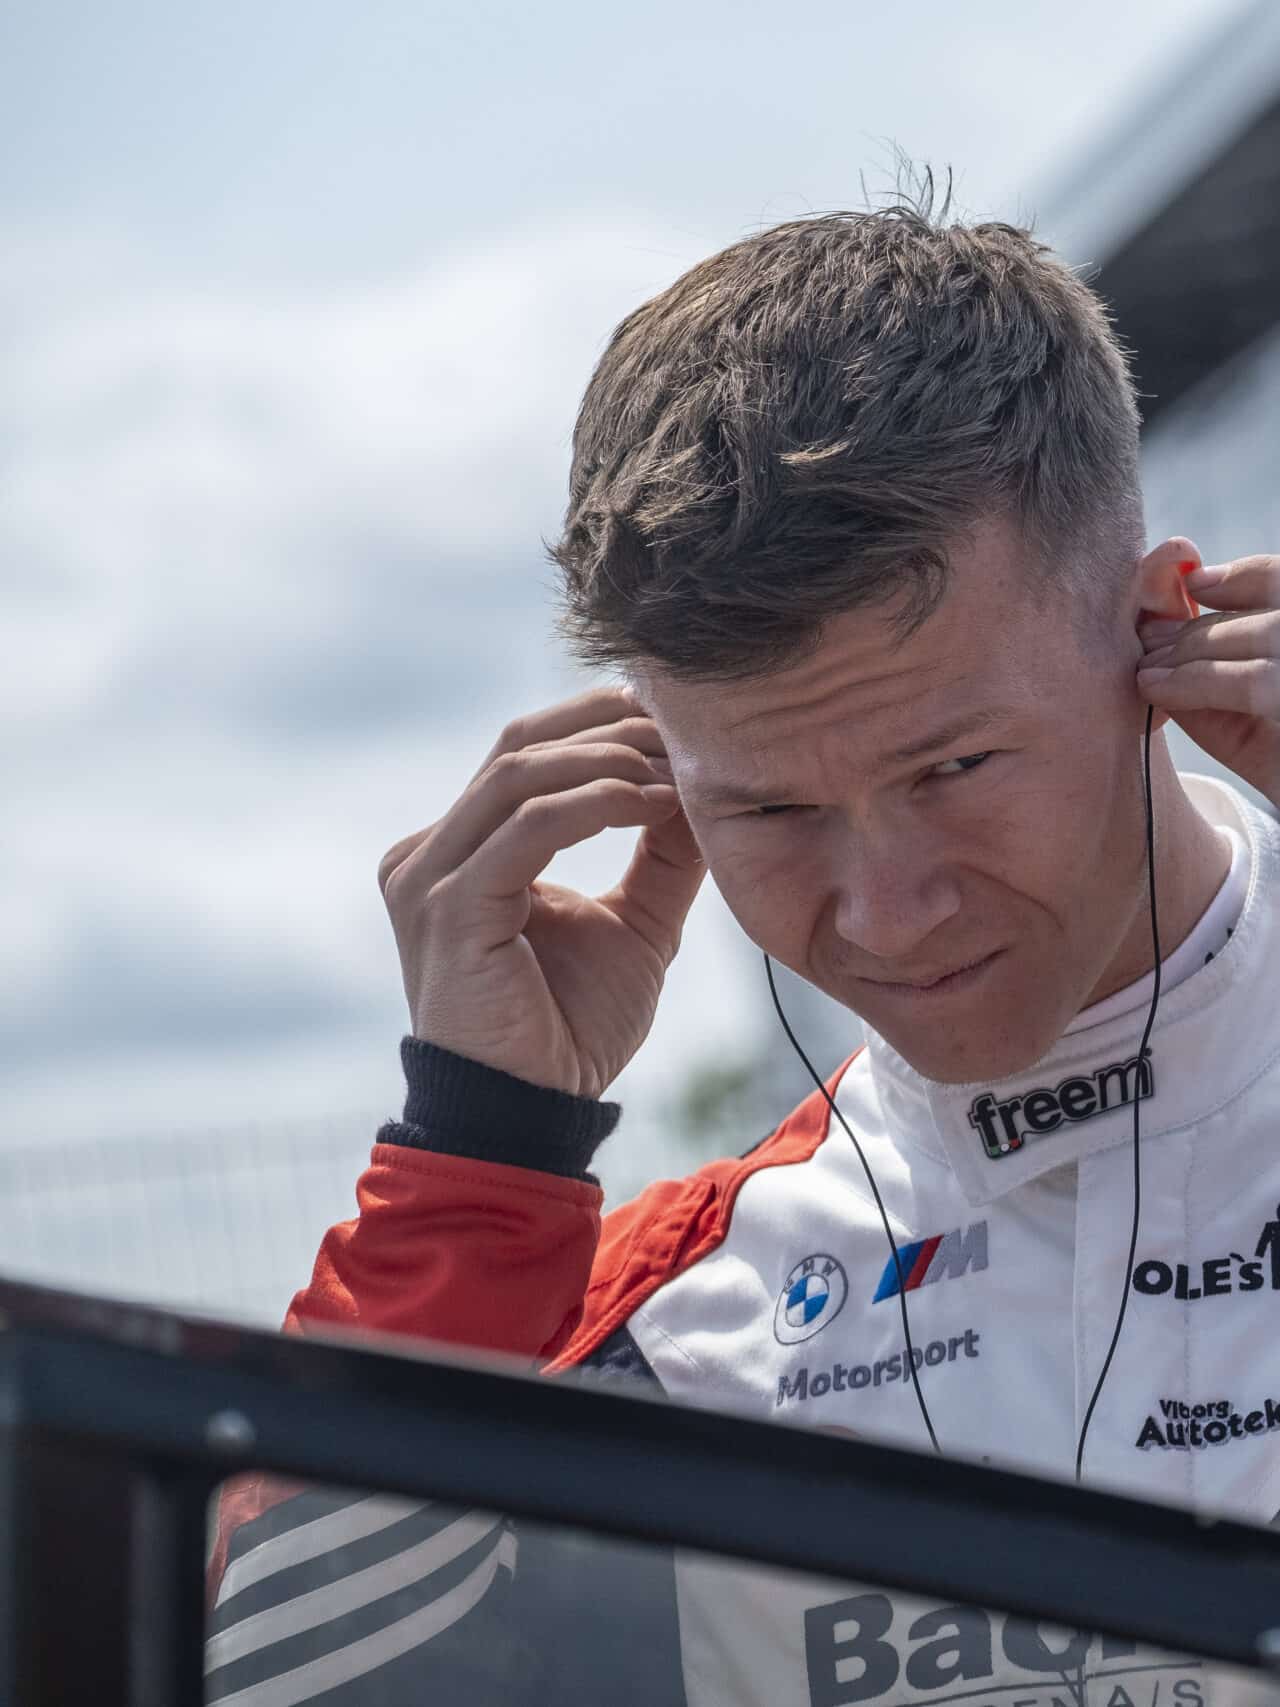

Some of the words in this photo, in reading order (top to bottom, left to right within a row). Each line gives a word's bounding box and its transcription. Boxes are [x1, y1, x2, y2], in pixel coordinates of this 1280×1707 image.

[970, 1057, 1151, 1157] freem
[777, 1329, 979, 1406] Motorsport
[804, 1594, 1137, 1707] Bac
